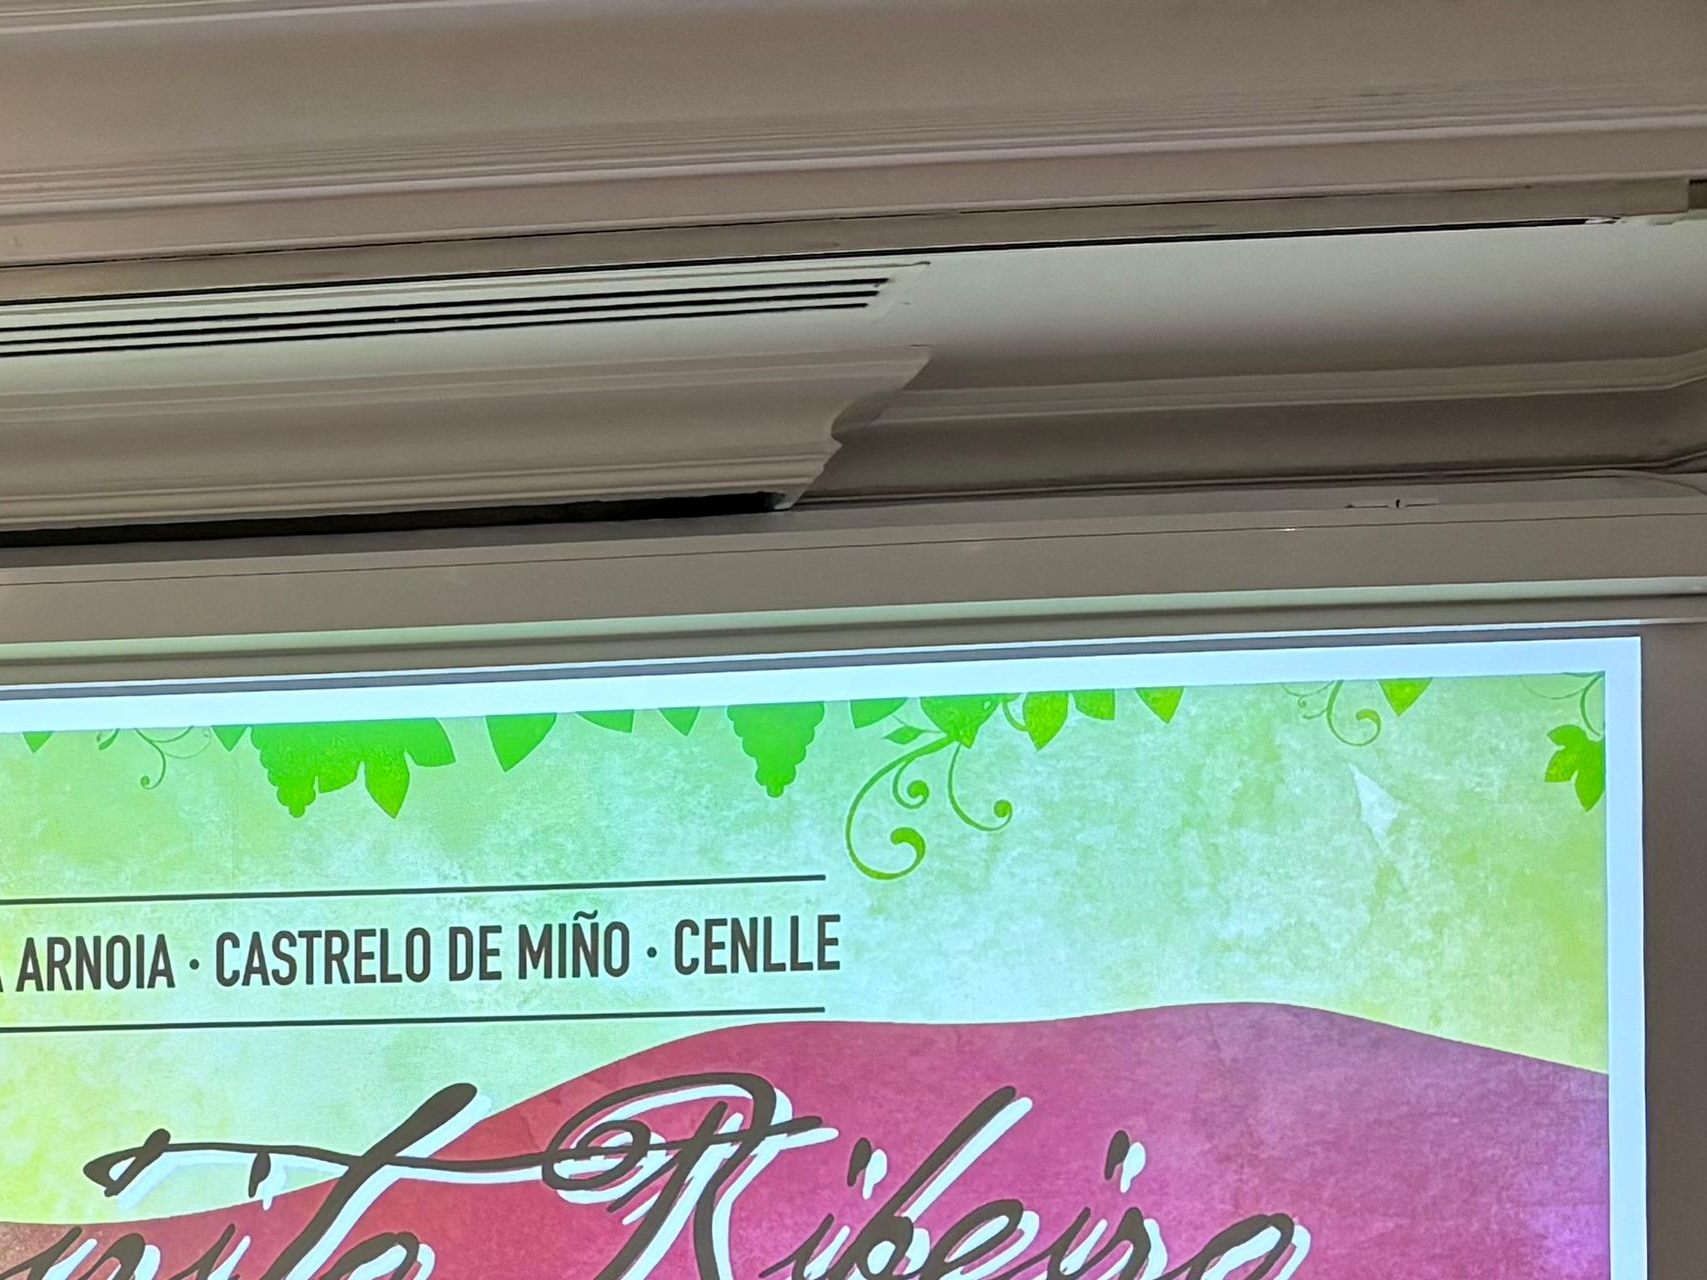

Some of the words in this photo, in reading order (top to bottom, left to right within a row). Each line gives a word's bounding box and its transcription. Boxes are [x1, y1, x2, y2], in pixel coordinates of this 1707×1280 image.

[15, 934, 176, 992] ARNOIA
[214, 925, 433, 988] CASTRELO
[448, 924, 502, 982] DE
[517, 910, 631, 981] MIÑO
[672, 913, 841, 974] CENLLE
